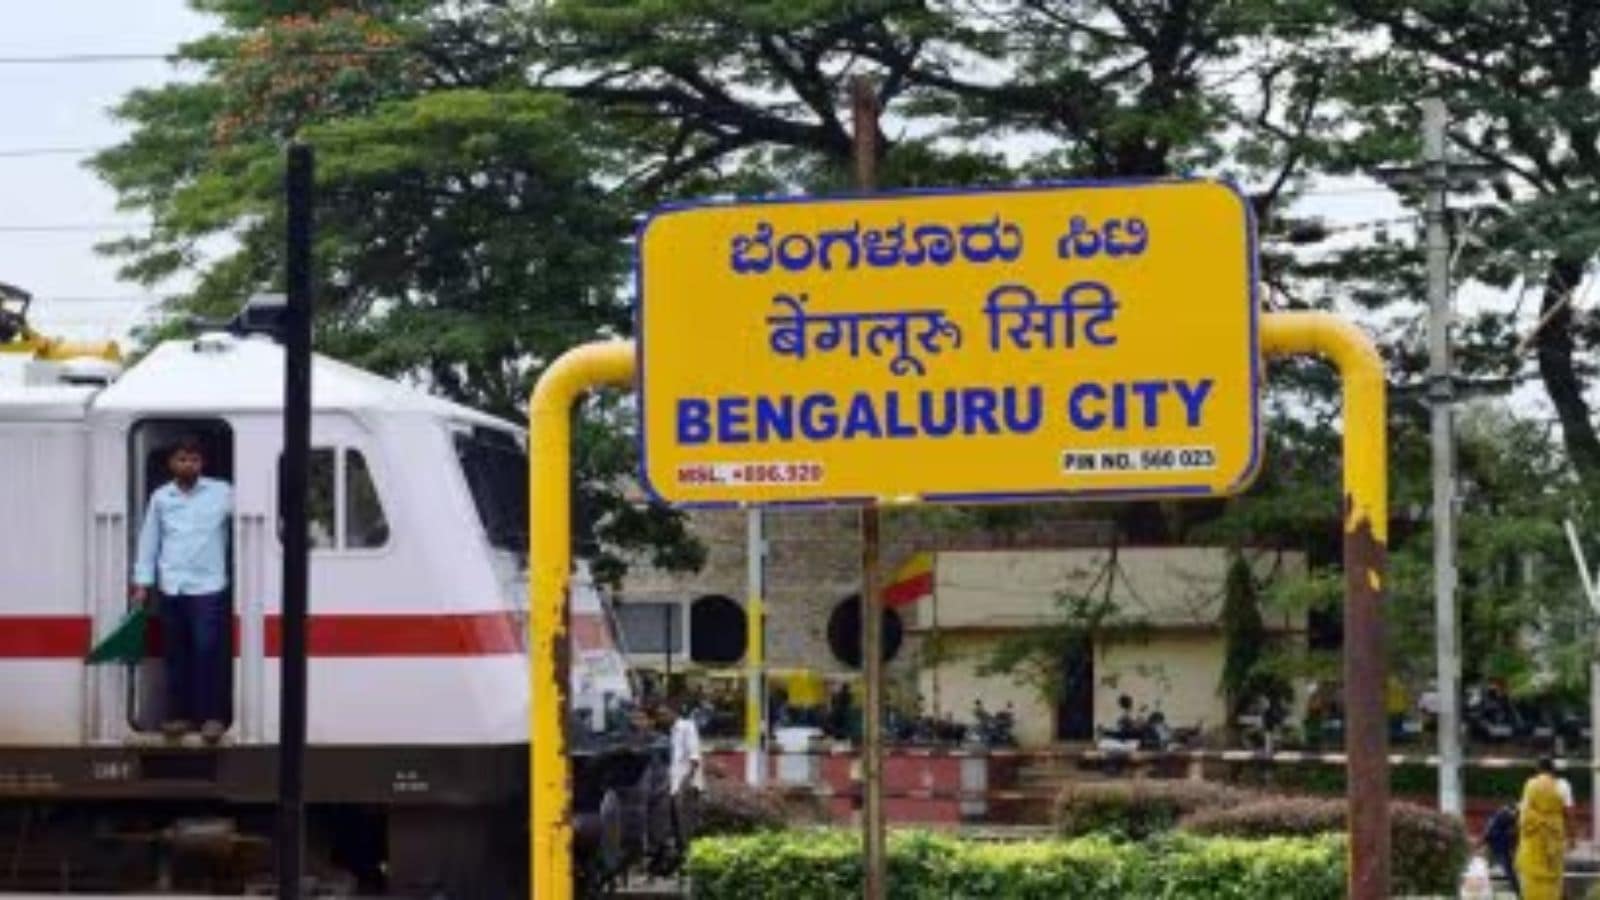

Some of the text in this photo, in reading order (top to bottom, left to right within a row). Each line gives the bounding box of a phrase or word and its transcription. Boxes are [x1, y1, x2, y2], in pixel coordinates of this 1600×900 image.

[730, 214, 1149, 274] ಬೆಂಗಳೂರು ಸಿಟಿ
[983, 281, 1121, 352] सिटि
[676, 379, 1214, 446] BENGALURU CITY
[1064, 449, 1215, 471] PIN NO. 560 023
